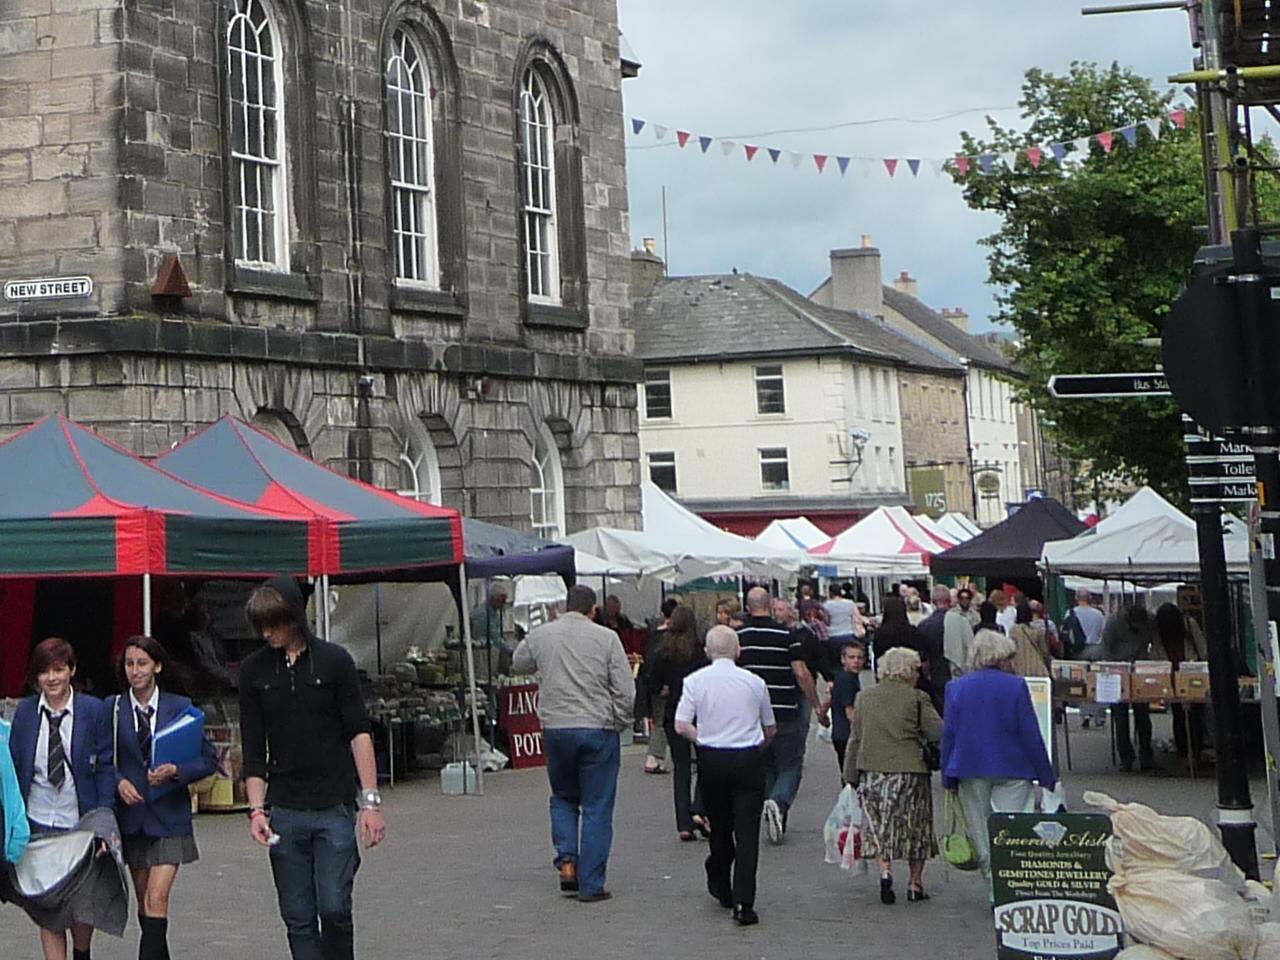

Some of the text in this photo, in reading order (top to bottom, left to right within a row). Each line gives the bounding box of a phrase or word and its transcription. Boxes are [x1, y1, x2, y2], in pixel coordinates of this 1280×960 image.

[10, 281, 86, 297] NEW STREET
[1133, 379, 1151, 390] Bus
[924, 491, 946, 513] 1725
[1020, 860, 1083, 870] DIAMONDS &
[998, 869, 1108, 881] GEMSTONES JEWELLERY
[1036, 880, 1060, 889] GOLD
[1070, 881, 1101, 890] SILVER
[1000, 903, 1119, 936] SCRAP GOLD
[1023, 937, 1095, 950] Top Prices Paid
